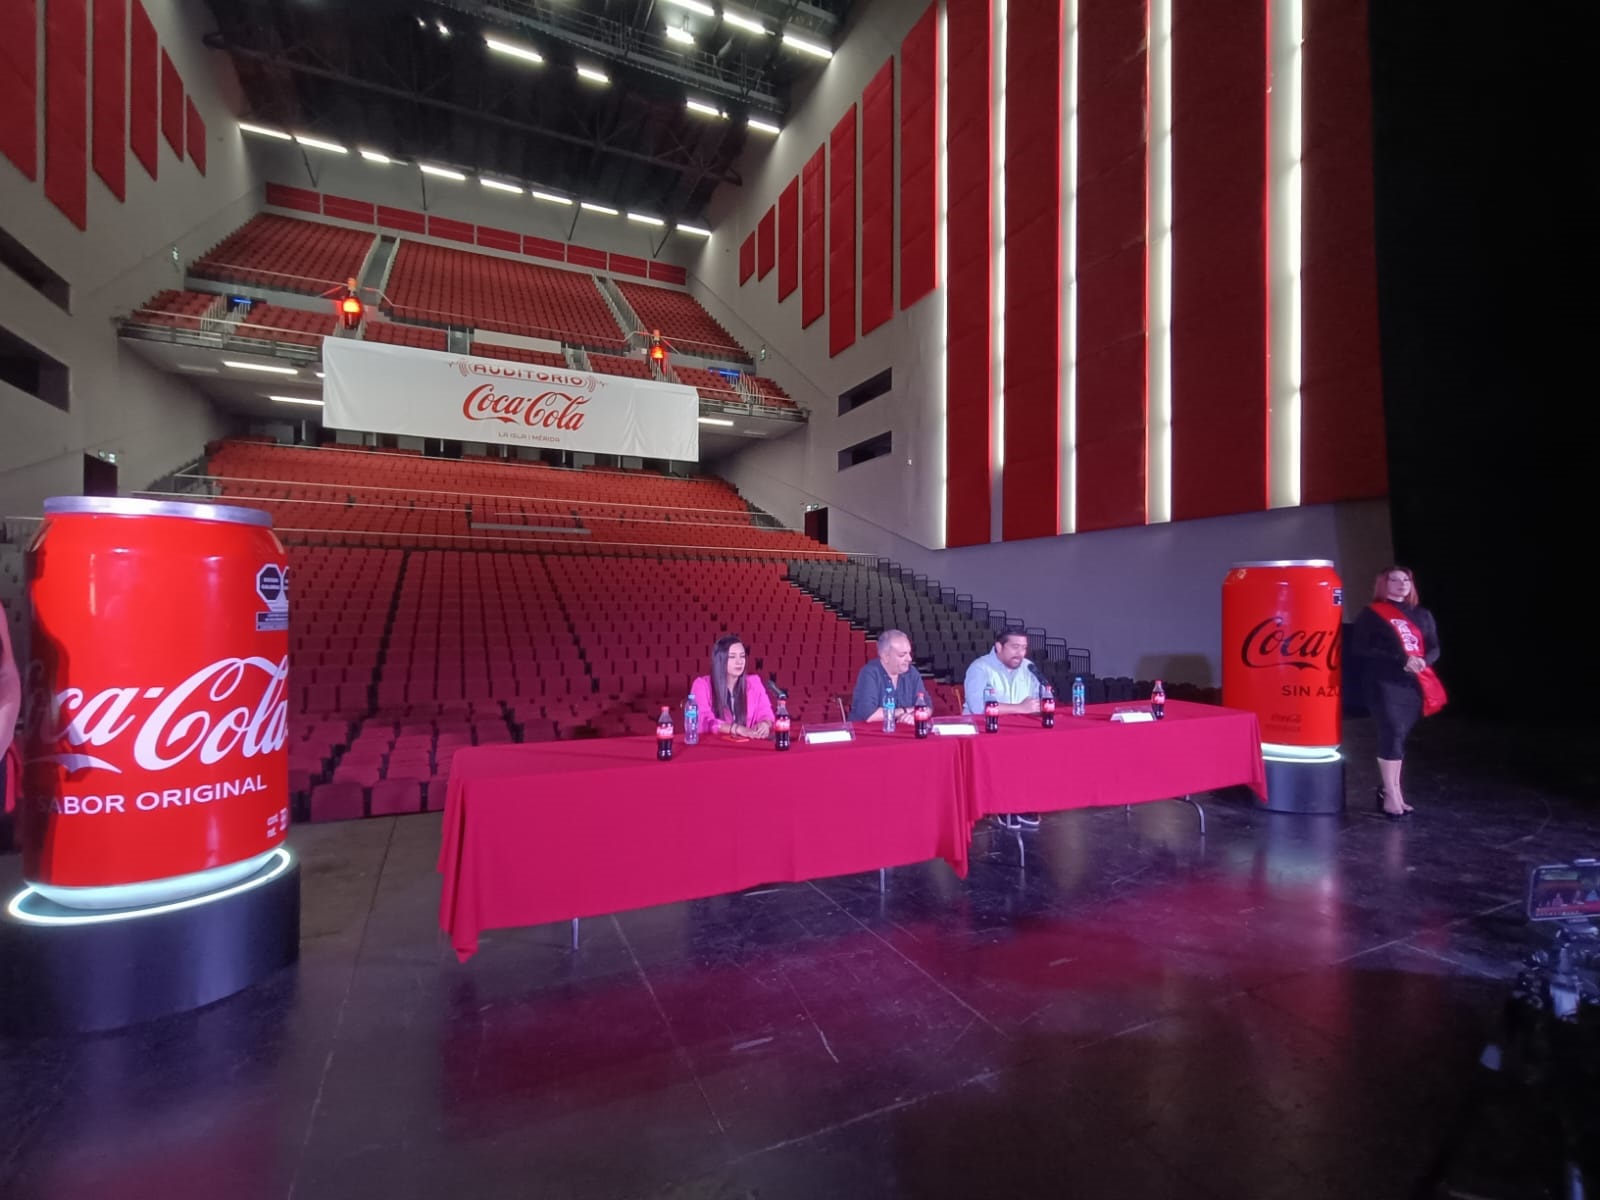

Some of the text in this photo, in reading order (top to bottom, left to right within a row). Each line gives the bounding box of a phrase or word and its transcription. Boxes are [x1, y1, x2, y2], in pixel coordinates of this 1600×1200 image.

[473, 363, 583, 386] AUDITORIO
[462, 383, 592, 431] Coca-Cola
[1281, 685, 1311, 697] SIN
[40, 775, 267, 814] ABOR ORIGINAL
